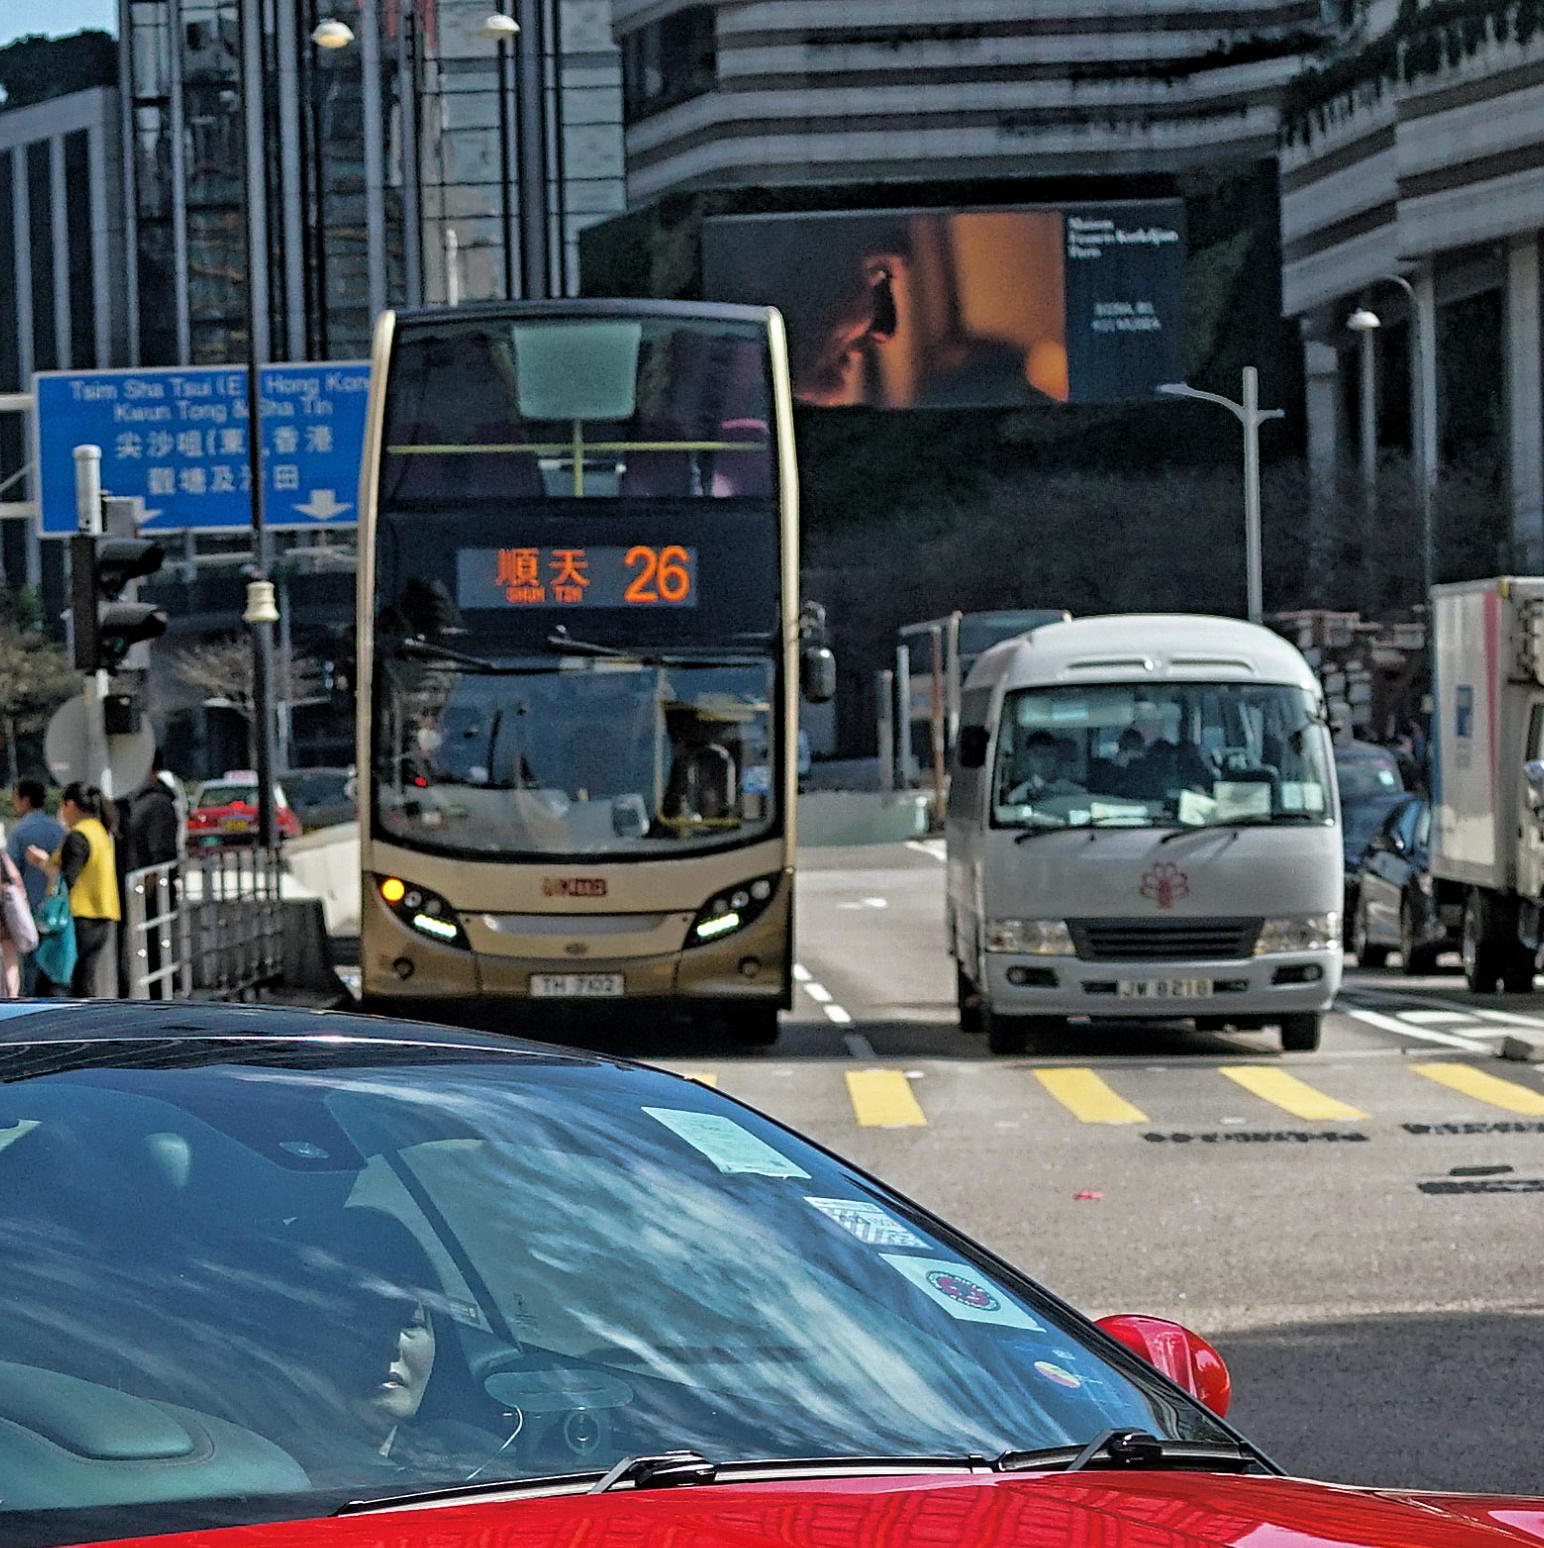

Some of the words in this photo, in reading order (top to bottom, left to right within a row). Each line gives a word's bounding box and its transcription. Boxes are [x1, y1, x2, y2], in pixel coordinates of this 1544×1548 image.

[69, 380, 117, 400] Tsim
[124, 378, 165, 399] Sha
[169, 376, 212, 397] Tsui
[265, 374, 319, 400] Hong
[326, 373, 368, 393] Kon
[113, 403, 171, 423] Kwun
[176, 400, 227, 423] Tong
[302, 396, 333, 416] Tin
[495, 547, 590, 587] 順天
[623, 545, 691, 603] 26
